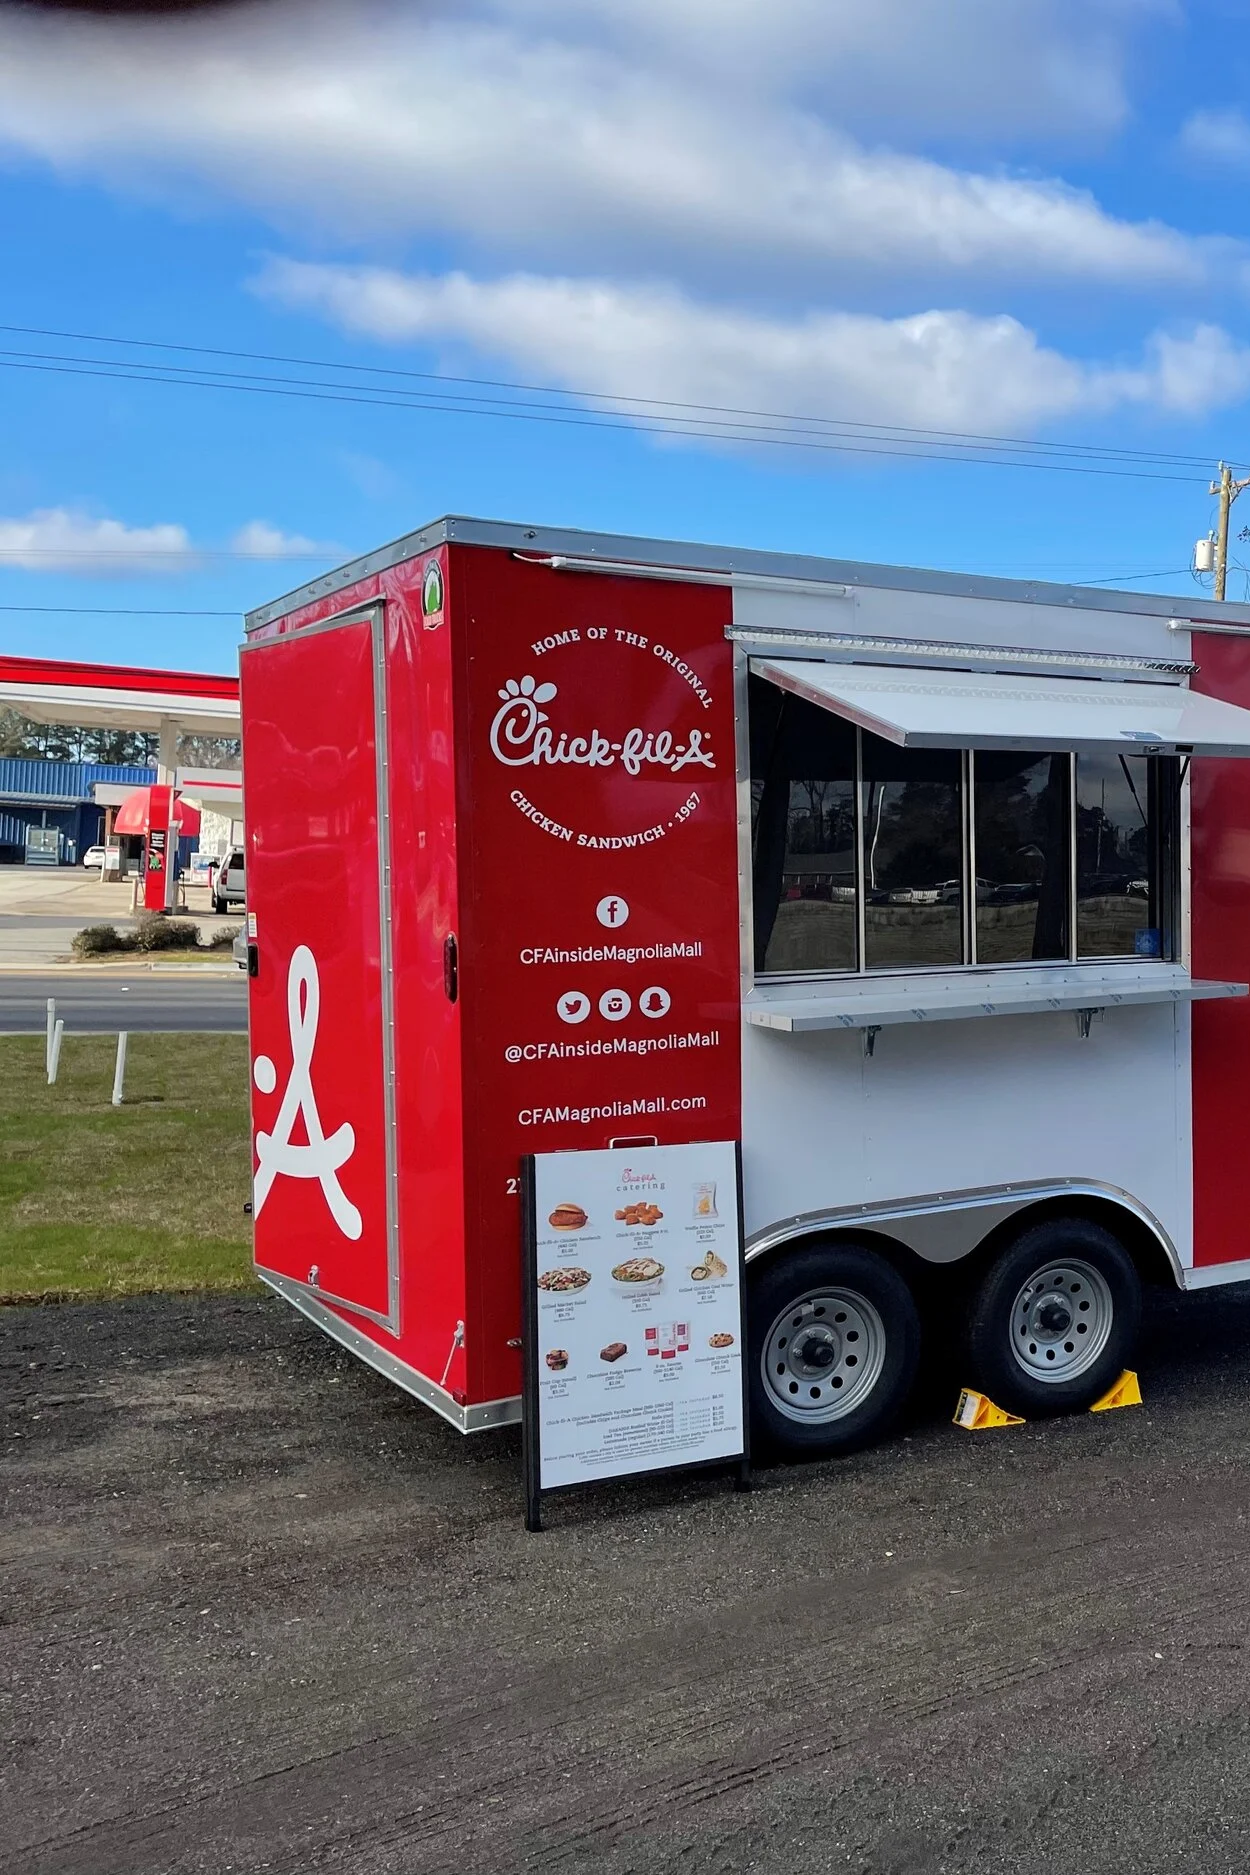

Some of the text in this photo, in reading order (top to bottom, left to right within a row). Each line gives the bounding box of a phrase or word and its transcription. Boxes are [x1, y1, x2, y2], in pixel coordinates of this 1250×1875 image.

[531, 627, 713, 709] HOME OF THE ORIGINAL
[490, 675, 717, 775] Chick-fil-A
[510, 790, 701, 849] CHICKEN SANDWICH 1967
[520, 942, 702, 964] CFAinsideMagnoliaMall
[505, 1031, 719, 1063] @CFAinsideMagnoliaMall
[518, 1096, 706, 1125] CFAMagnoliaMall.com
[616, 1182, 666, 1193] catering
